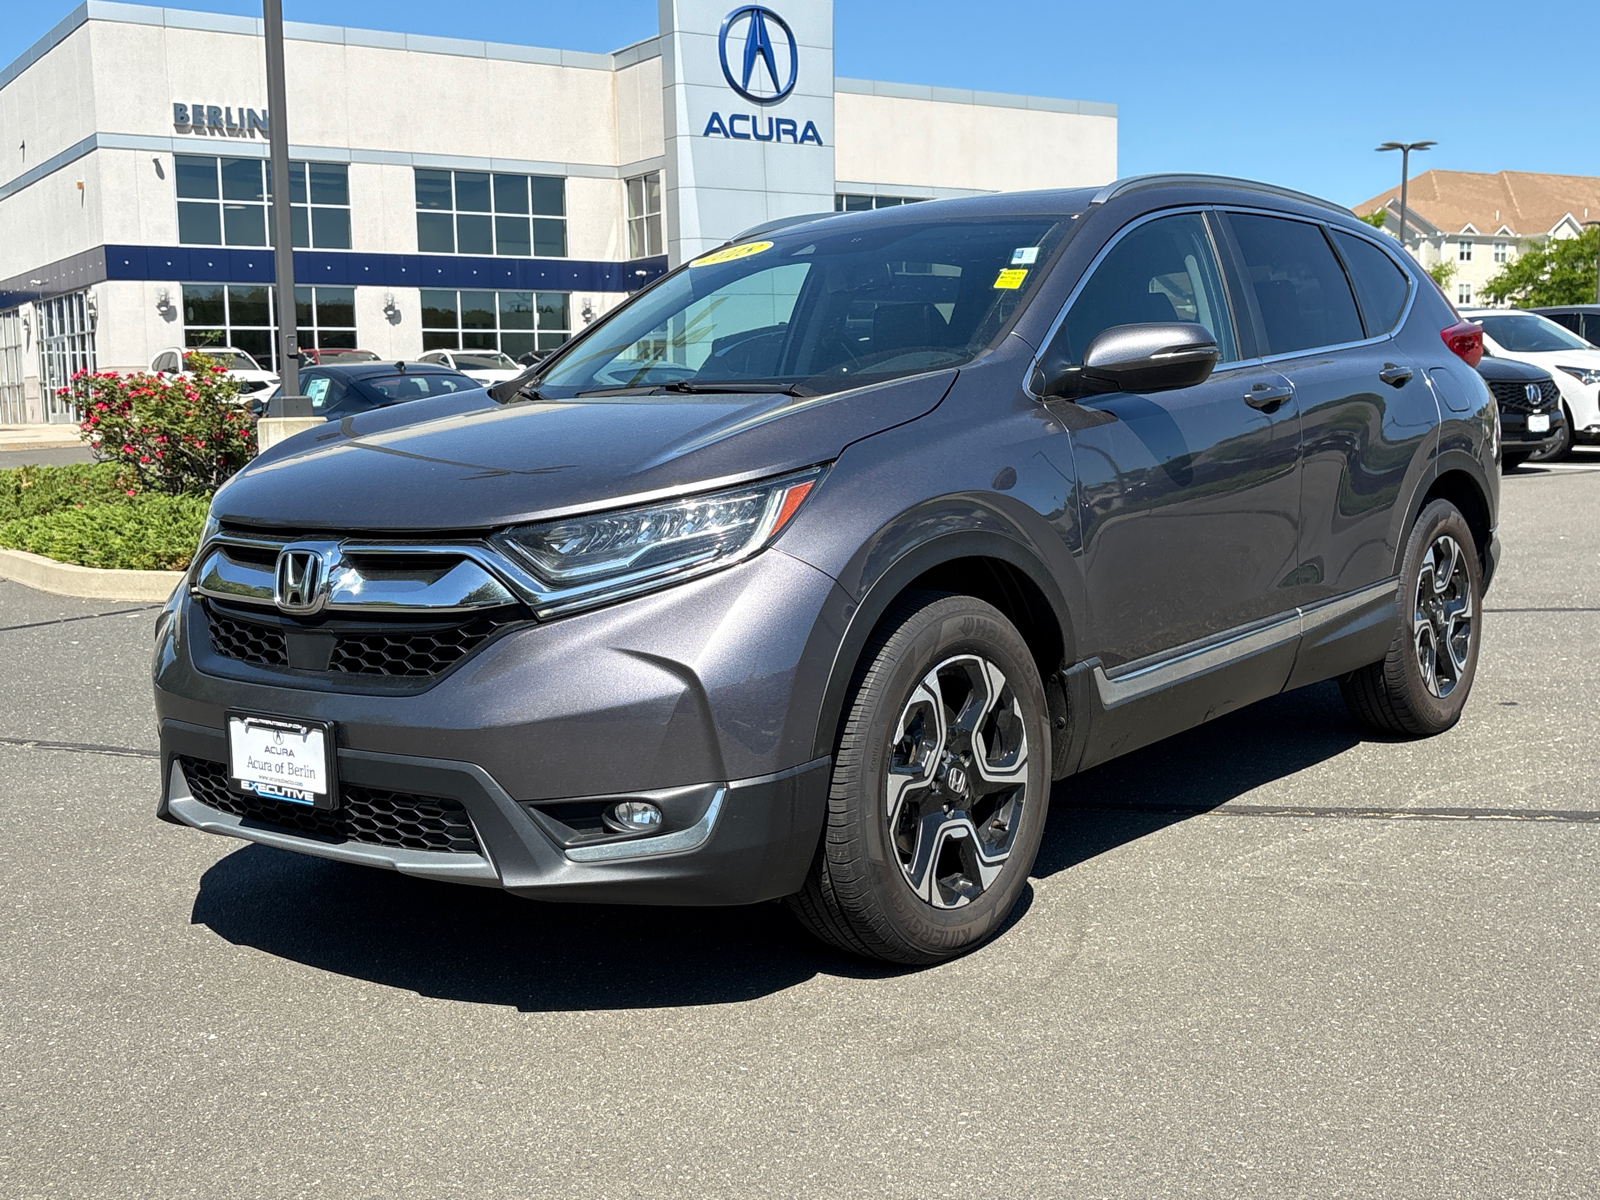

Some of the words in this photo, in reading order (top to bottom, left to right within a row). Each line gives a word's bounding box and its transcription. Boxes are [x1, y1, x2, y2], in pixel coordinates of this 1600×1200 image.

[173, 102, 269, 131] BERLIN
[703, 112, 823, 146] ACURA
[264, 745, 296, 758] ACURA
[246, 755, 273, 773] Acura
[274, 762, 285, 775] of
[287, 761, 316, 780] Berlin
[240, 779, 315, 802] EXECUTIVE
